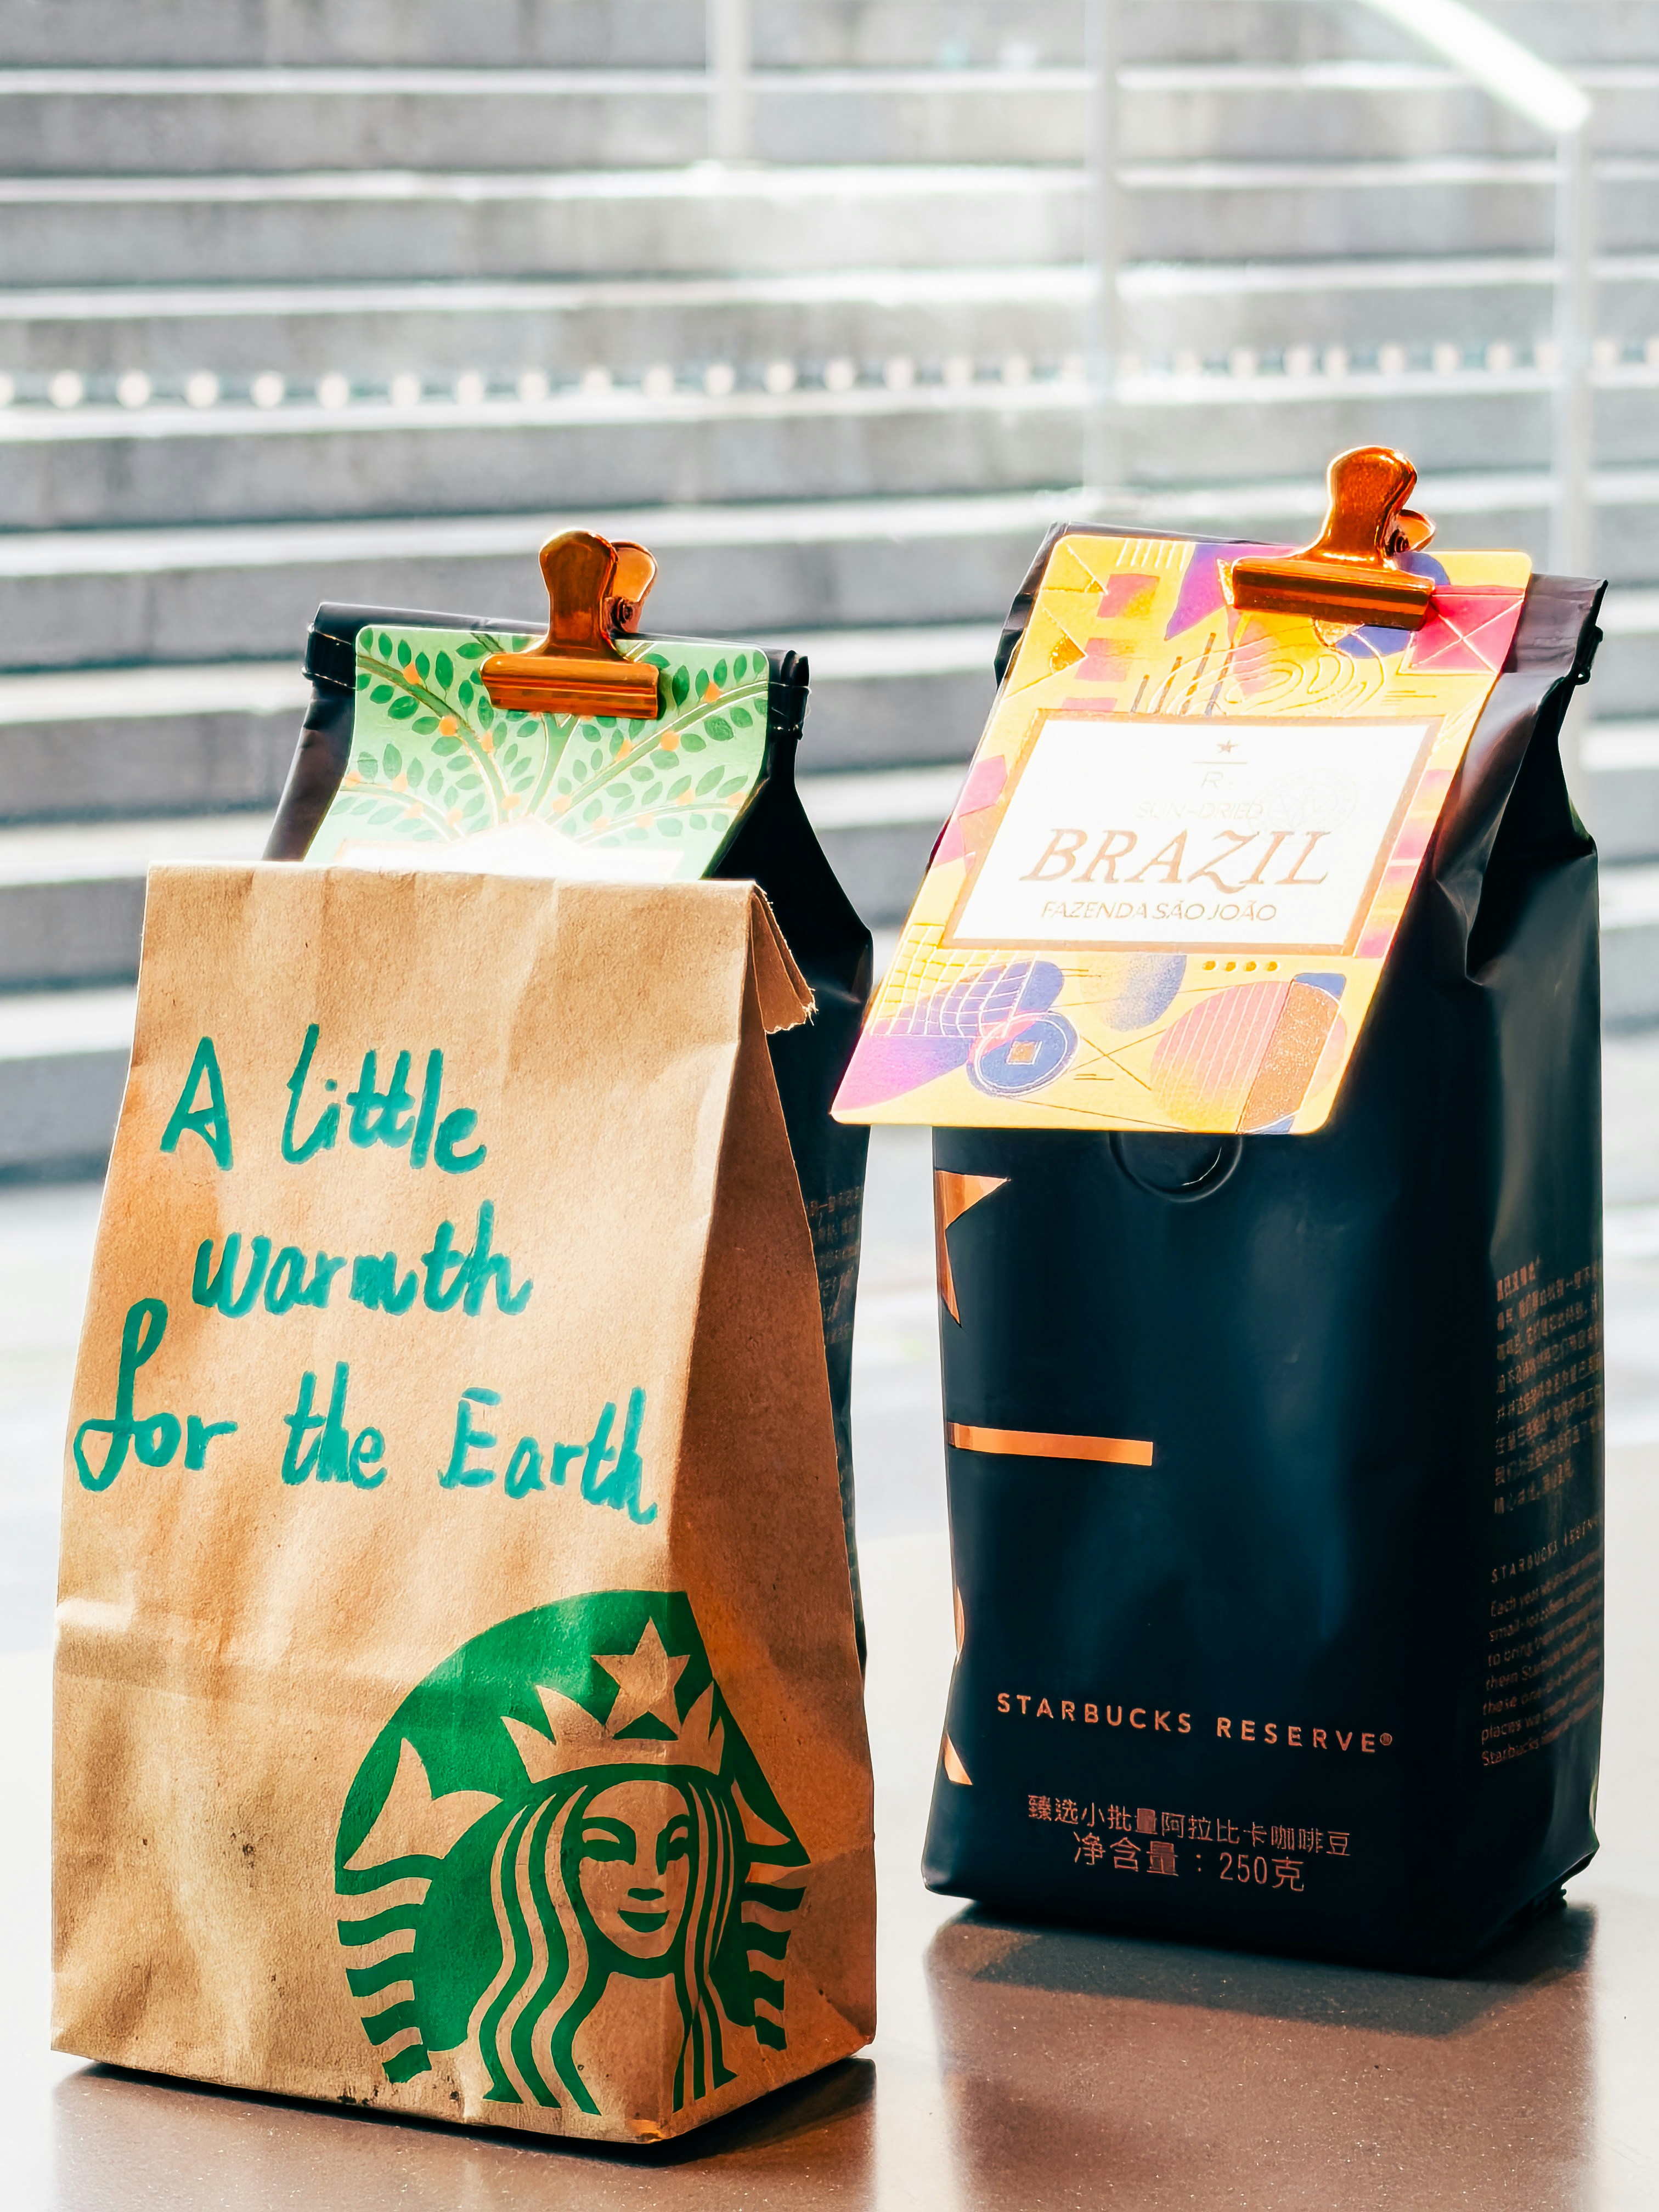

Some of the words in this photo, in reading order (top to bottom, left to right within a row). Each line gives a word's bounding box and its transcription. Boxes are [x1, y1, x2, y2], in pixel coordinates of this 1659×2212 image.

[1135, 800, 1264, 822] SUN-DRIED
[1018, 827, 1332, 895] BRAZIL
[1041, 900, 1148, 920] FAZENDA
[1156, 899, 1205, 921] SÃO
[1206, 899, 1277, 922] JOÃO
[161, 1037, 233, 1170] A
[281, 1024, 487, 1174] little
[191, 1200, 533, 1318] warmth
[73, 1297, 238, 1492] for
[281, 1362, 387, 1489] the
[438, 1386, 658, 1525] Earth
[997, 1692, 1192, 1733] STARBUCKS
[1028, 1795, 1351, 1857] 臻选小批量阿拉比卡咖啡豆
